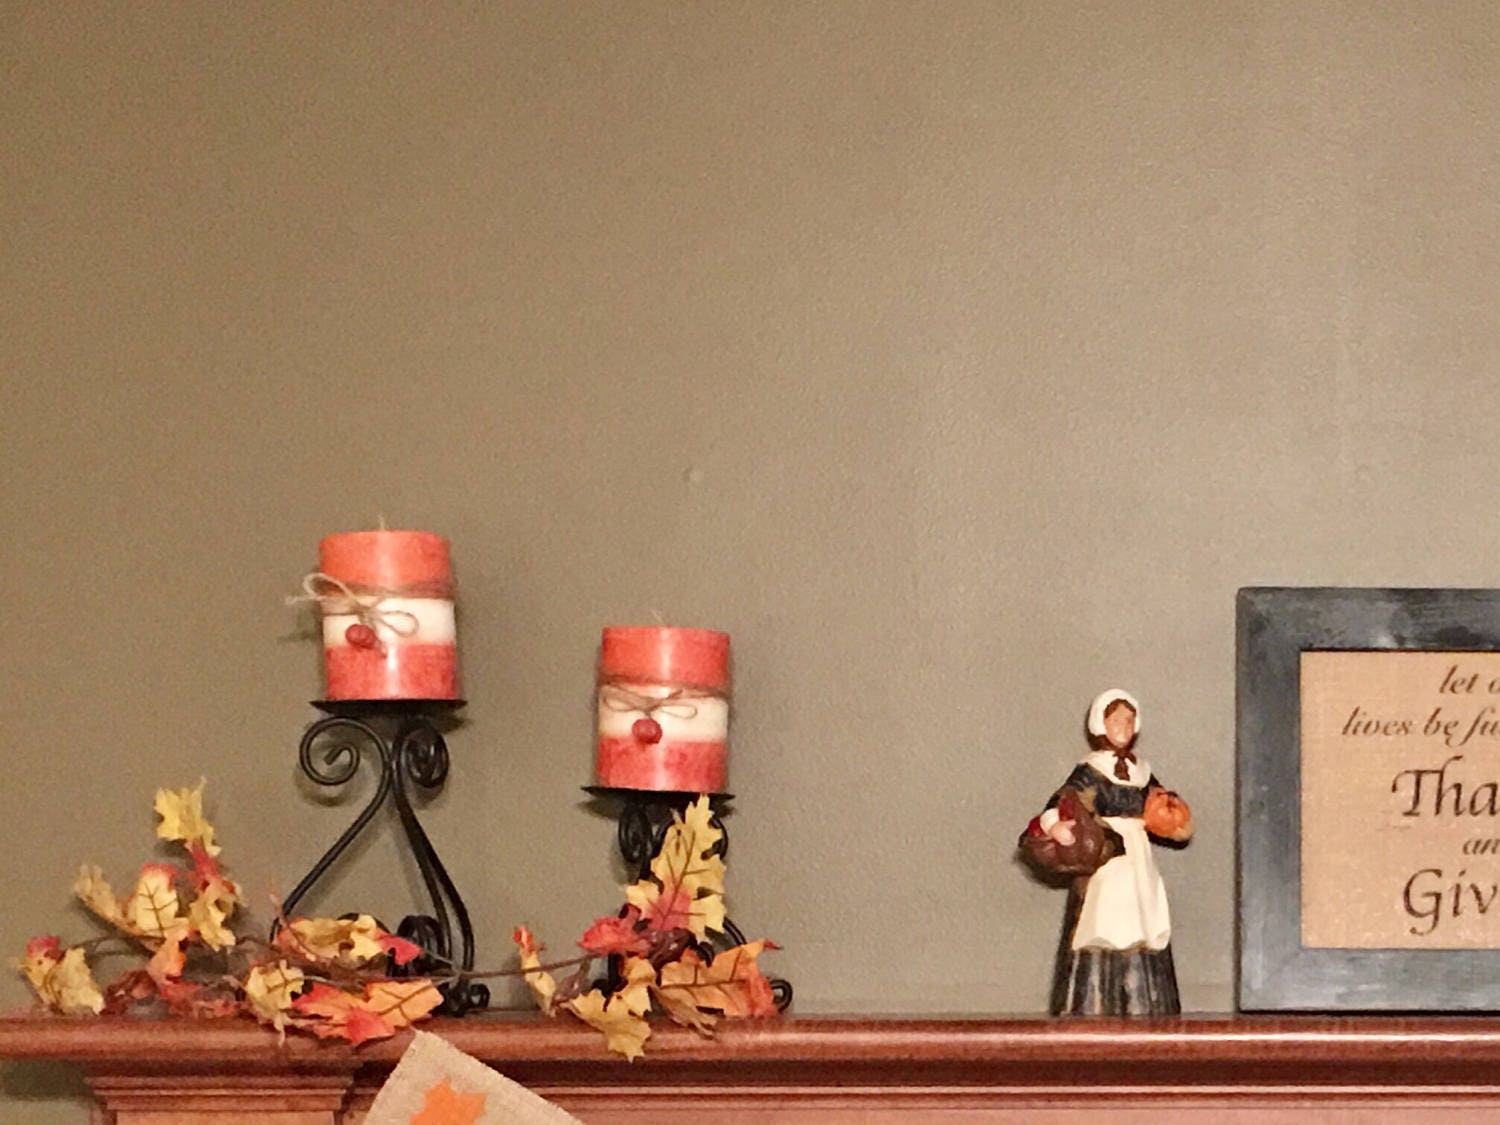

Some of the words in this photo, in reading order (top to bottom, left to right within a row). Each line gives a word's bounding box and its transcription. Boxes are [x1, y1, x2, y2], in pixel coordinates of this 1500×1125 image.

[1438, 664, 1478, 695] let
[1341, 706, 1413, 737] lives
[1423, 706, 1459, 747] be
